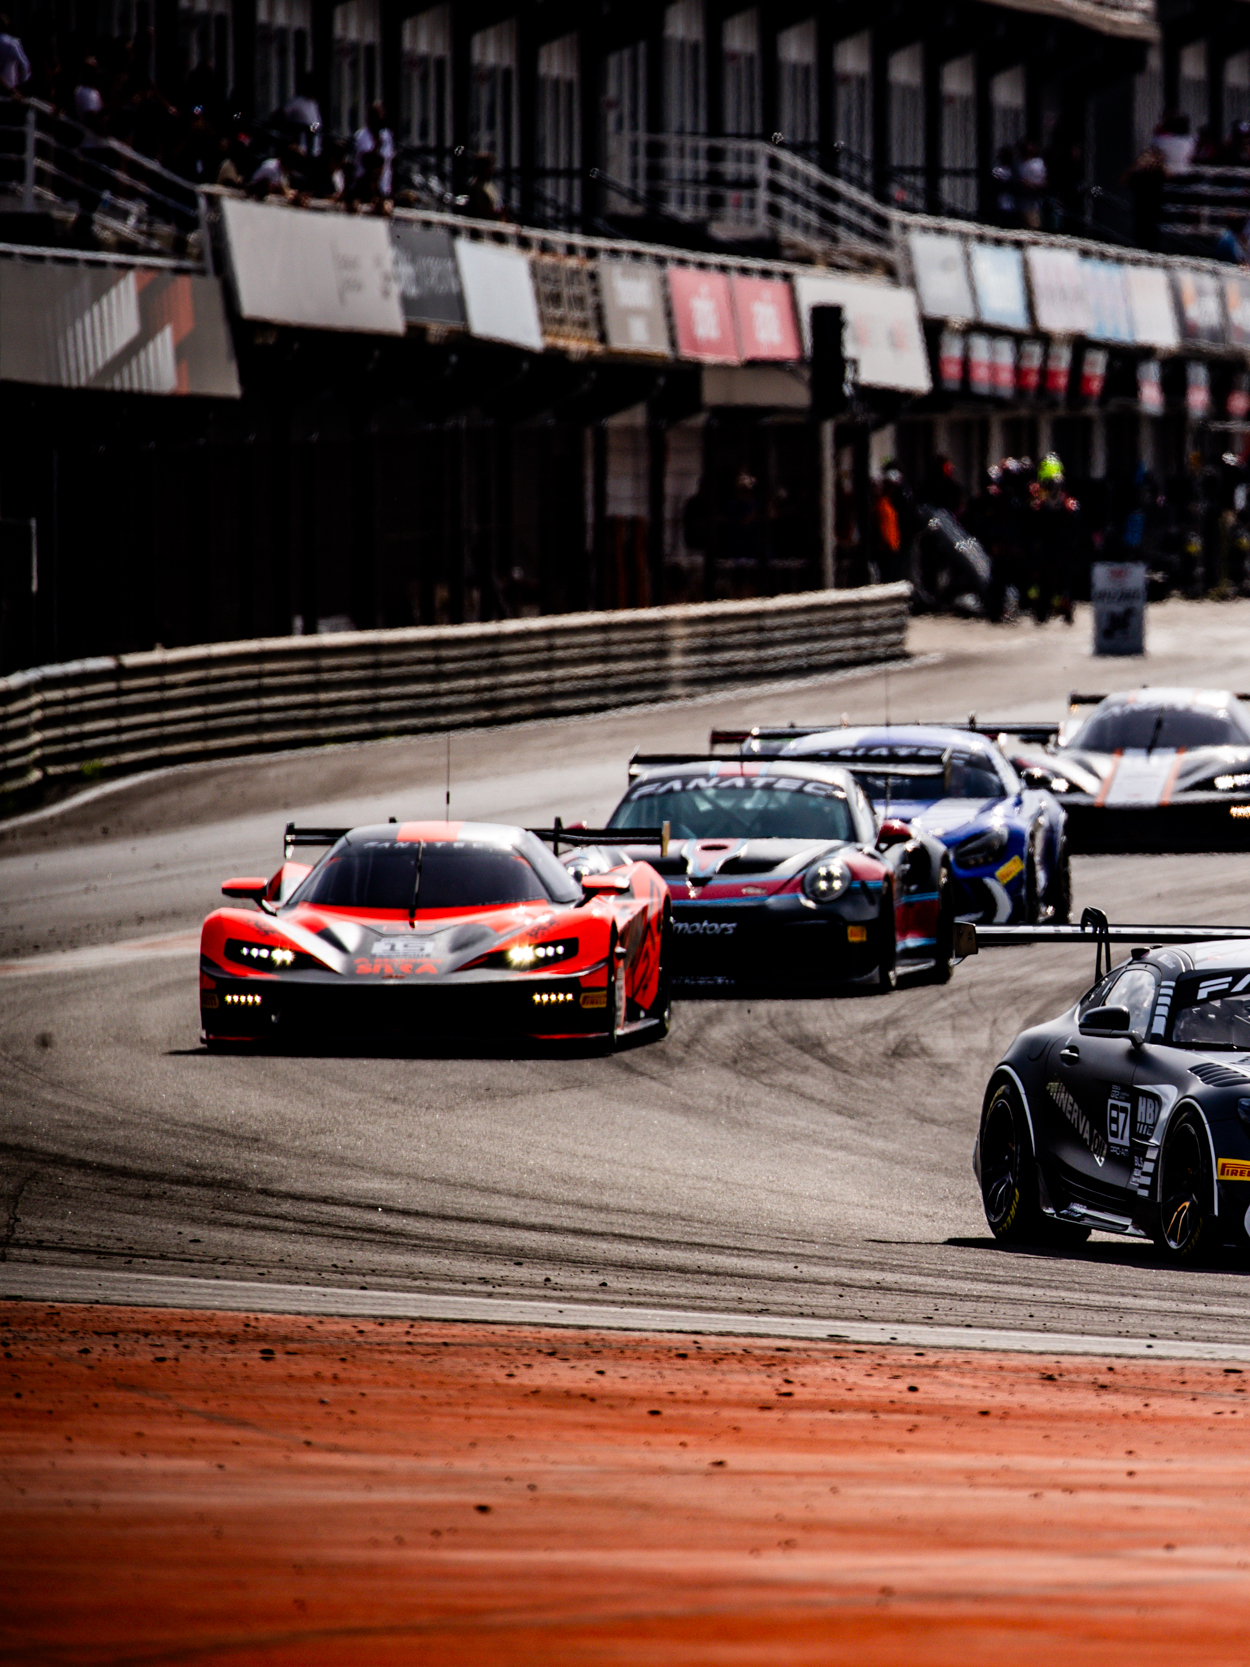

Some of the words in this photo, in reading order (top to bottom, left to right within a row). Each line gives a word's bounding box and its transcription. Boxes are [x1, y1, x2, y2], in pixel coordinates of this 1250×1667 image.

[631, 776, 834, 801] FANATEC
[673, 919, 738, 935] motors
[381, 941, 427, 953] 15
[1046, 1082, 1091, 1147] MINERVA
[1108, 1102, 1130, 1141] 87
[1136, 1095, 1160, 1125] HBI
